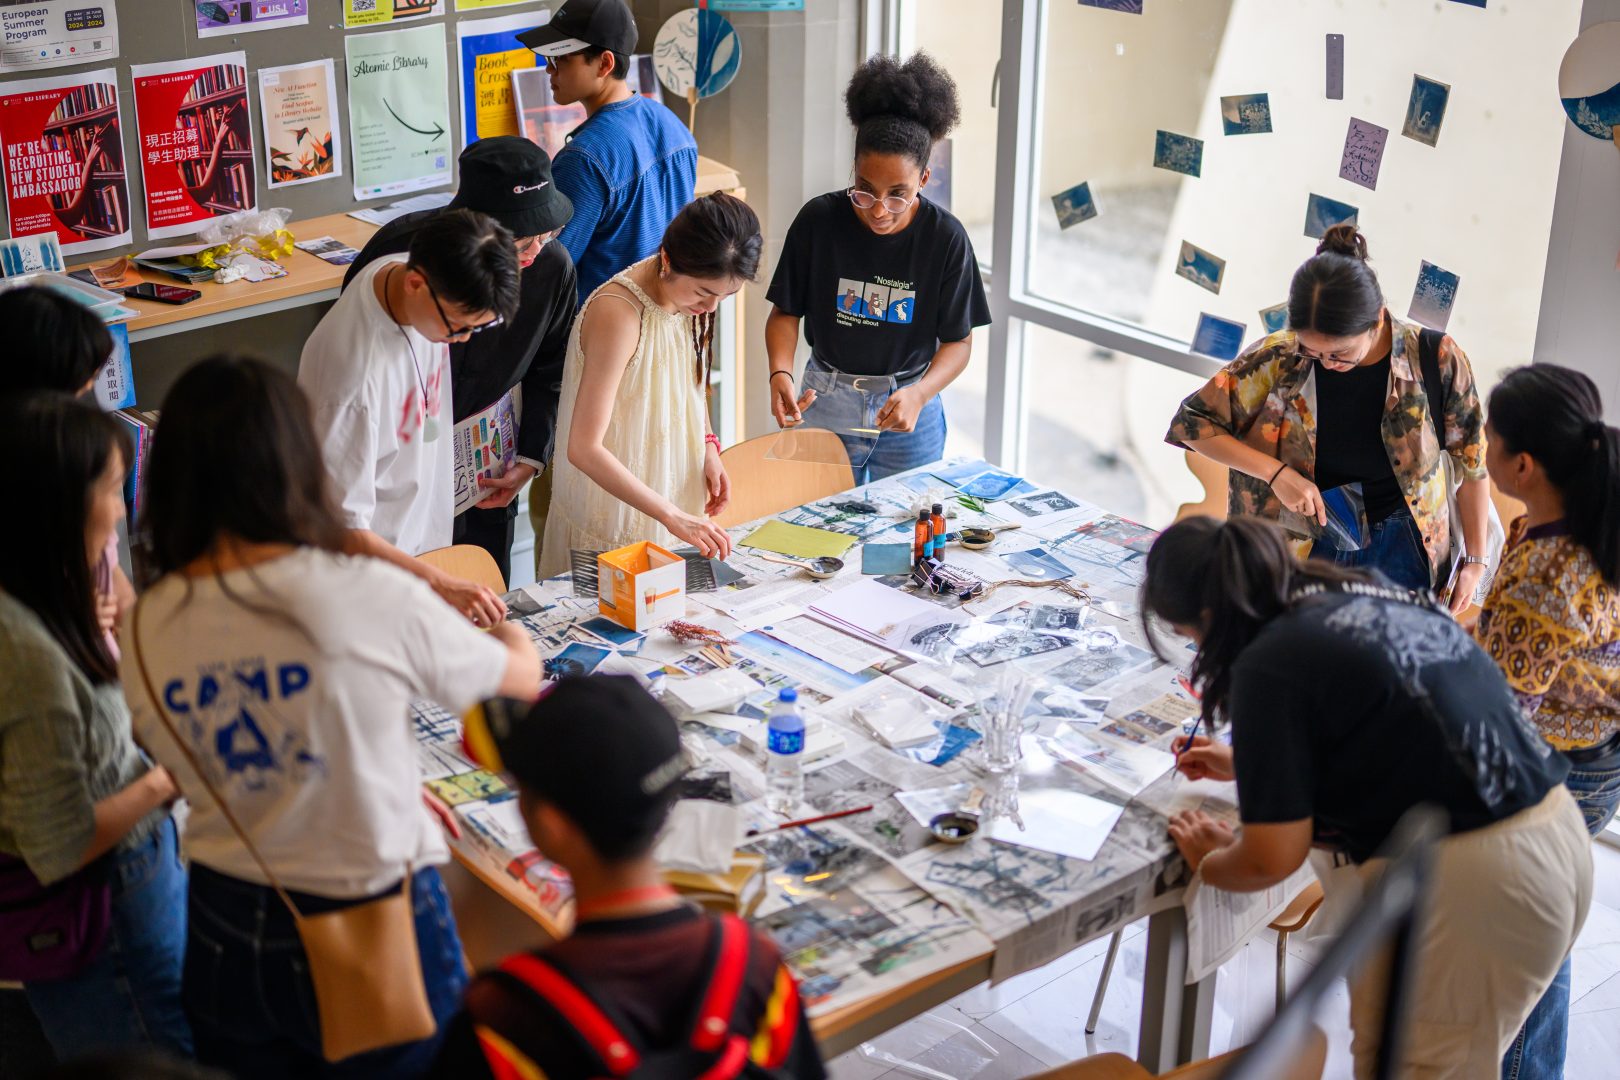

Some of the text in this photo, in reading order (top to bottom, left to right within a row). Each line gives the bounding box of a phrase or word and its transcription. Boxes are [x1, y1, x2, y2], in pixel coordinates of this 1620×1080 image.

[2, 8, 49, 20] European
[4, 18, 45, 30] Summer
[6, 28, 47, 40] Program
[353, 55, 429, 77] Atomic Library
[479, 54, 509, 71] Book
[171, 74, 195, 82] LIBRARY
[479, 68, 514, 84] Cross
[294, 82, 317, 92] Function
[36, 93, 61, 101] LIBRARY
[281, 109, 302, 118] Library
[145, 128, 199, 149] 現正招募
[7, 141, 41, 158] WE'RE
[148, 144, 200, 166] 學生助理
[10, 150, 72, 172] RECRUITING
[11, 162, 81, 185] NEW STUDENT
[13, 176, 82, 199] AMBASSADOR
[513, 181, 549, 194] Champion
[836, 312, 879, 327] disputing about
[164, 662, 311, 714] CAMP
